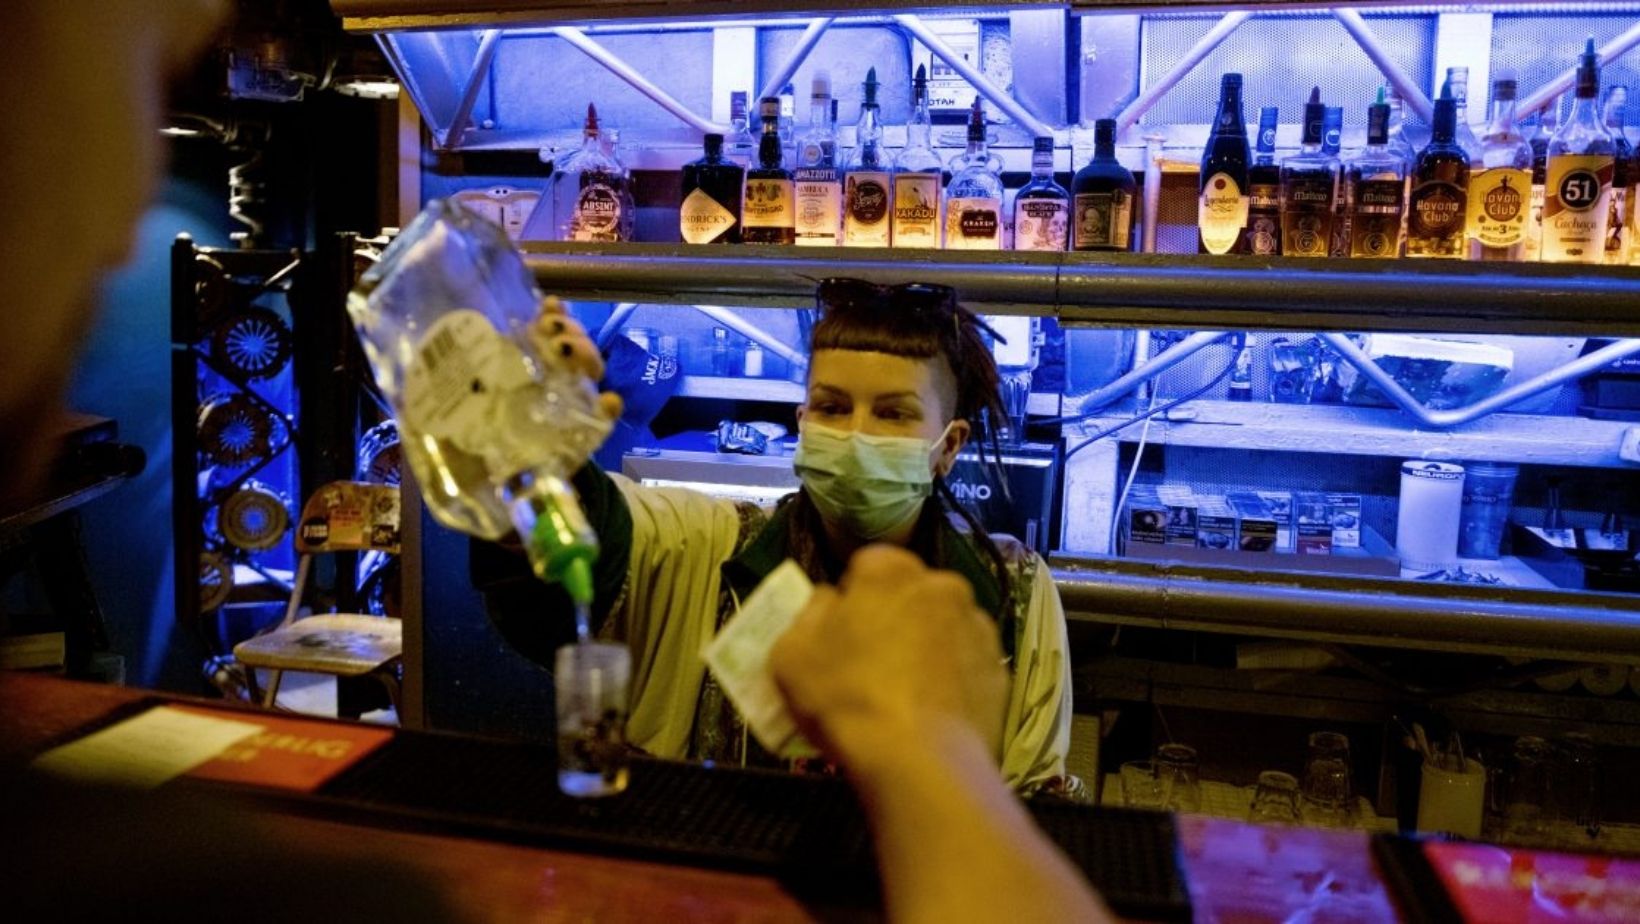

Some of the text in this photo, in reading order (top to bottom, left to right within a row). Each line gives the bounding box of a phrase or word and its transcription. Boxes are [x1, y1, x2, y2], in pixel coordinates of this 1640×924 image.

[1565, 180, 1593, 201] 51
[1416, 200, 1460, 212] Havana
[1489, 204, 1517, 216] Club
[896, 208, 935, 218] KAKADU
[1423, 211, 1450, 221] Club
[1499, 225, 1507, 234] 3
